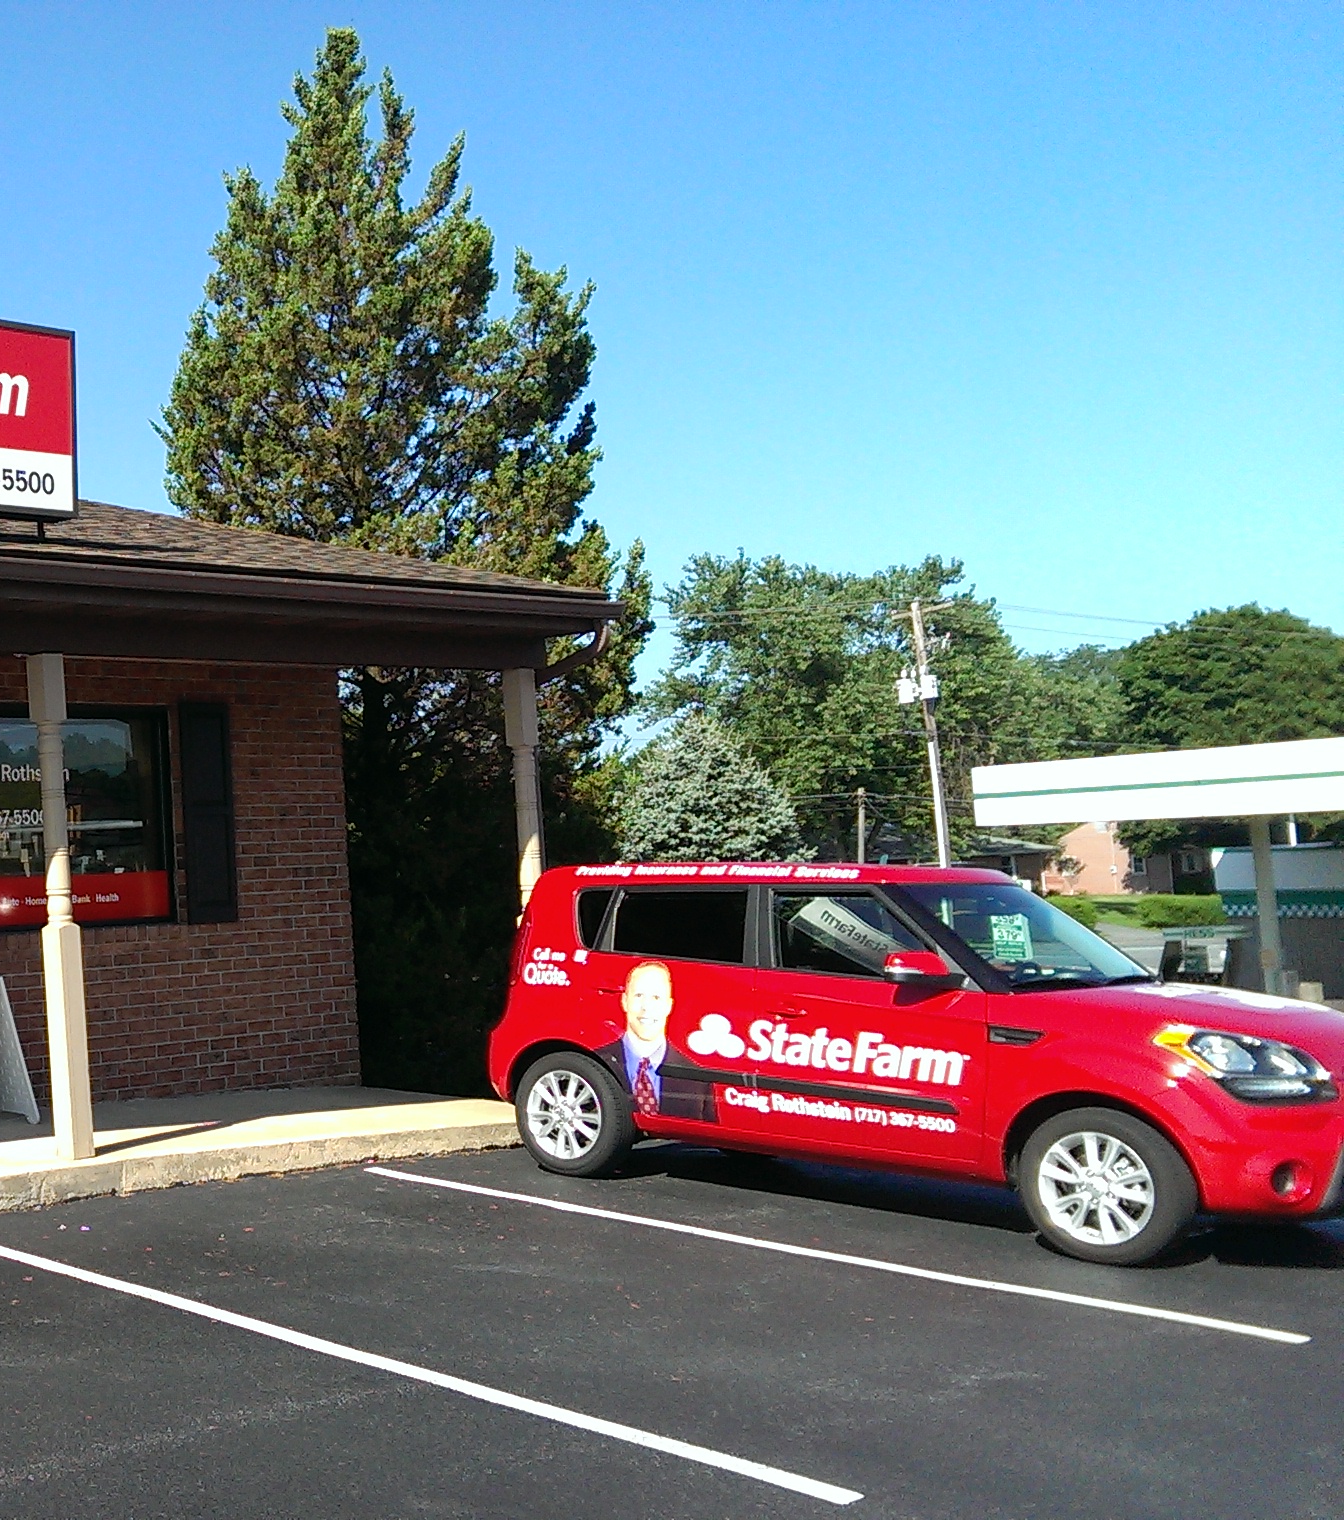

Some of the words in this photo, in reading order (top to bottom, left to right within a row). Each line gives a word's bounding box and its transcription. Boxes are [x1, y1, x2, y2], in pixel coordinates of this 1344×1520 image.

[575, 865, 633, 877] Providing
[635, 865, 698, 876] Insurance
[701, 865, 728, 876] and
[729, 865, 791, 877] Financial
[794, 866, 861, 879] Services
[96, 893, 119, 902] Health
[724, 1087, 770, 1113] Craig
[771, 1093, 851, 1122] Rothstein
[855, 1106, 887, 1126] (717)
[890, 1113, 956, 1133] 367-5500
